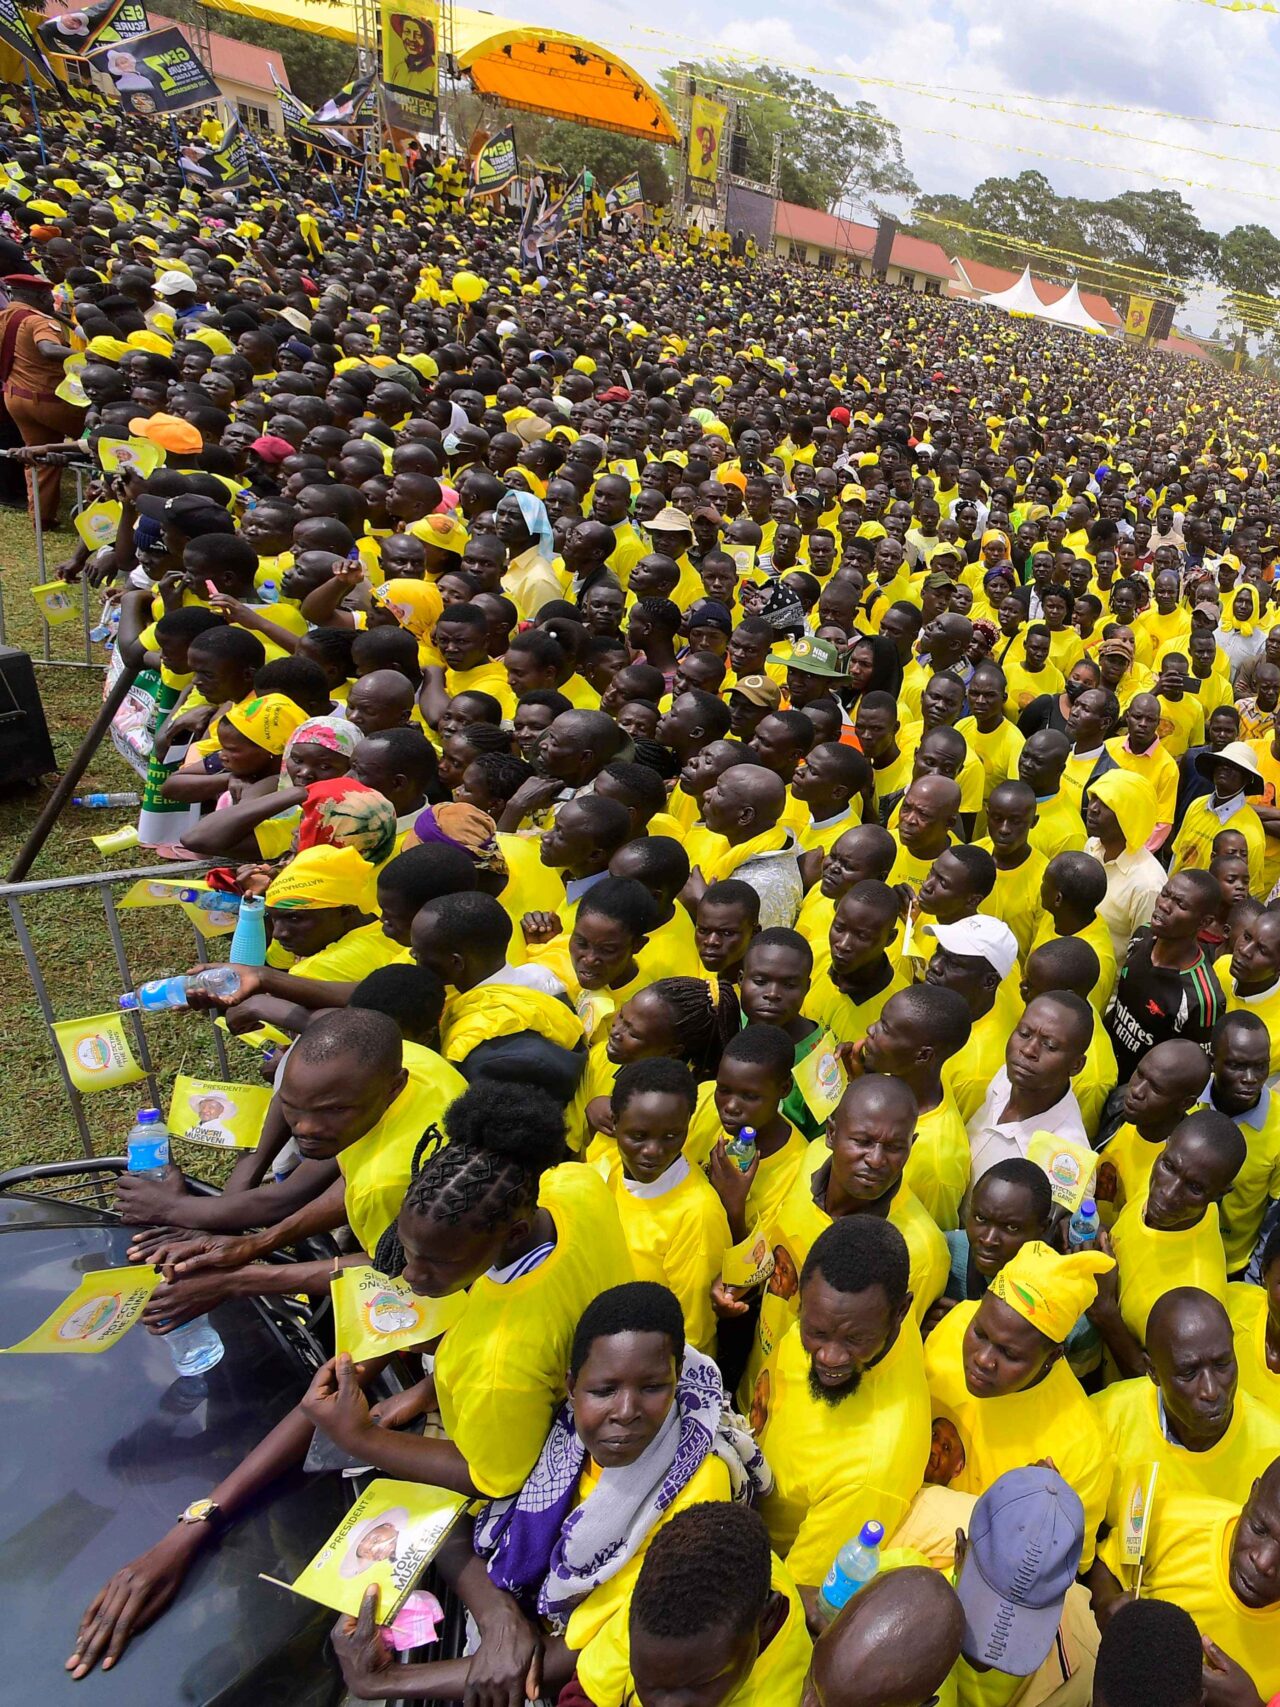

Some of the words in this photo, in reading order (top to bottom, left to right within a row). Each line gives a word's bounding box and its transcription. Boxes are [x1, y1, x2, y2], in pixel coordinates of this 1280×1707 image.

[1115, 1023, 1141, 1054] BETTER
[202, 1082, 242, 1093] PRESIDENT
[184, 1130, 226, 1144] MUSEVENI
[190, 1125, 223, 1138] YOWERI
[329, 1498, 370, 1550] PRESIDENT
